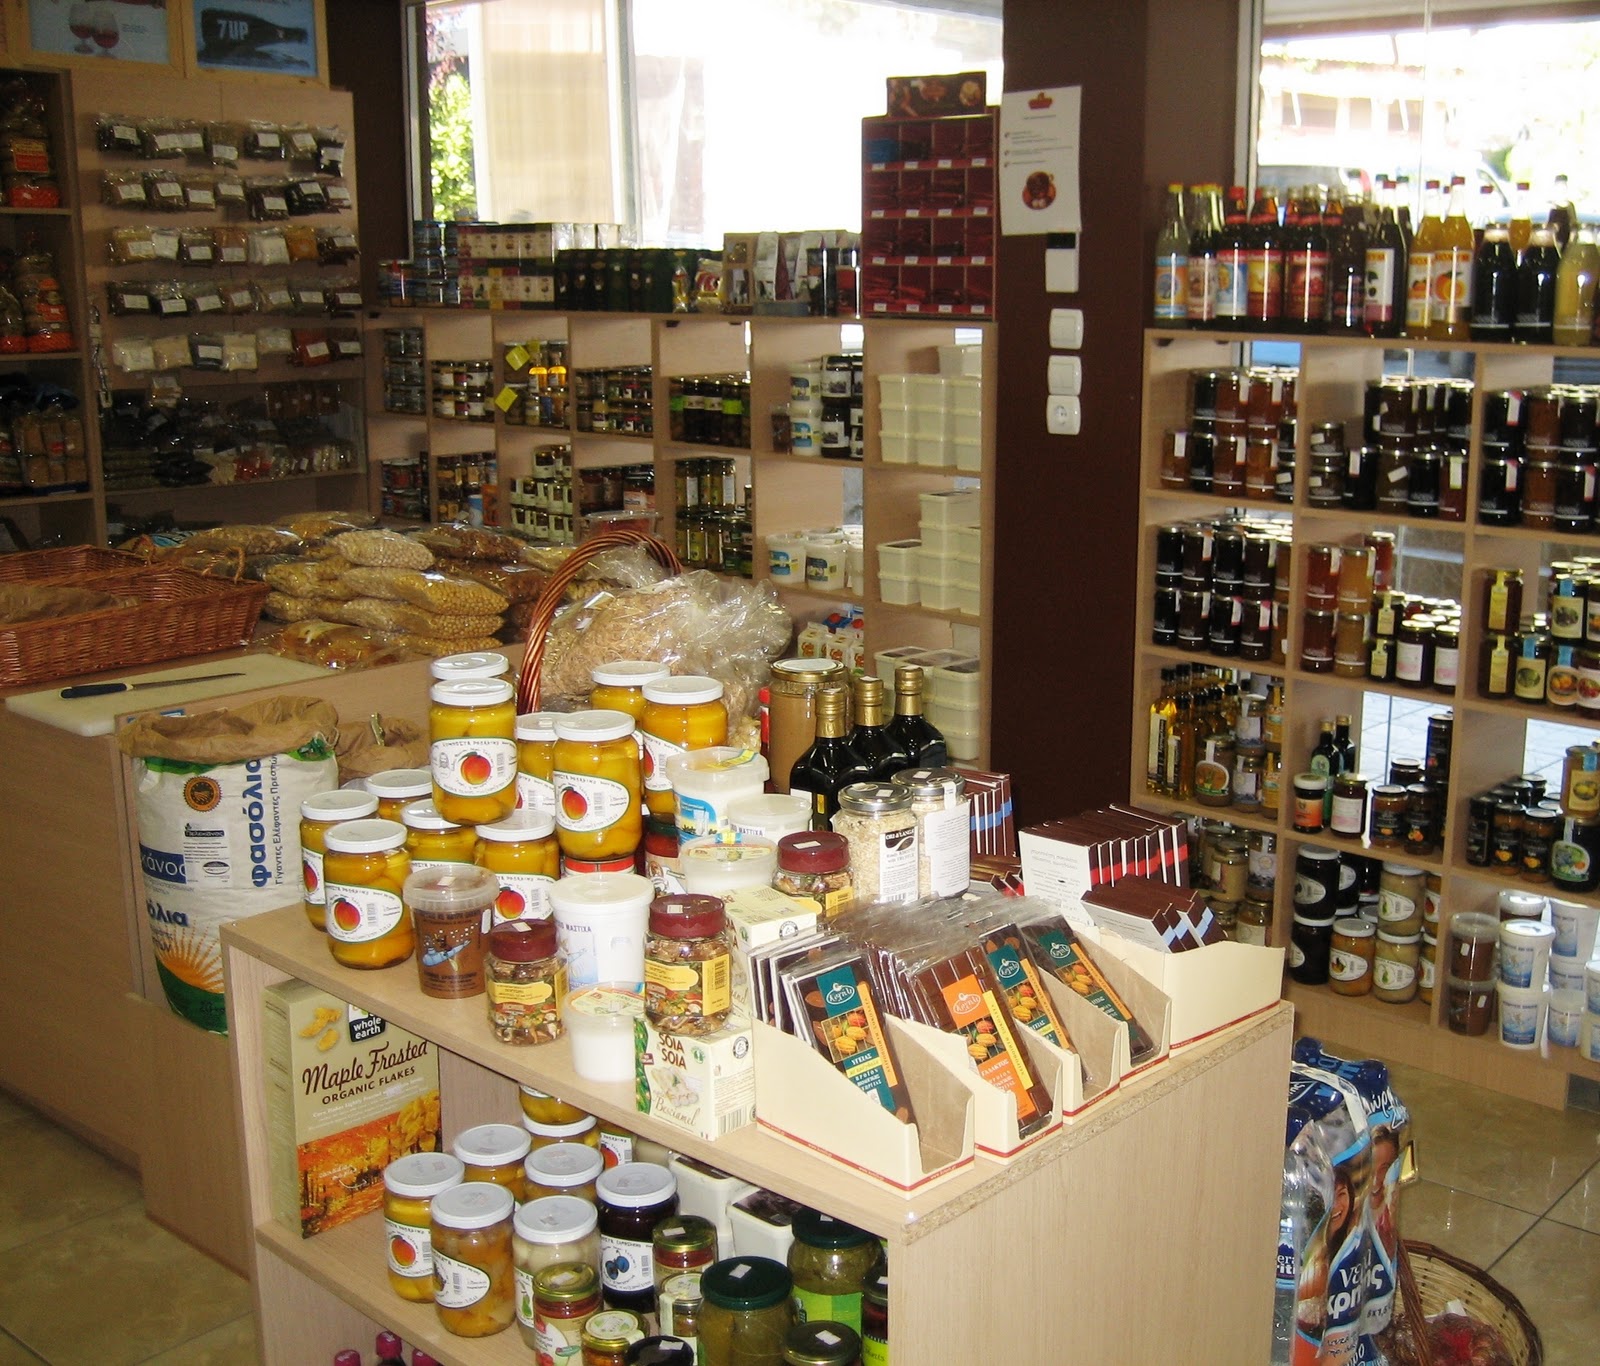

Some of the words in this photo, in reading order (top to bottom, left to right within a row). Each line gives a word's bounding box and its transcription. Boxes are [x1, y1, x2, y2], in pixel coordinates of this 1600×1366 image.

[353, 1016, 382, 1032] whole
[355, 1026, 381, 1040] earth
[658, 1033, 685, 1054] SOIA
[302, 1056, 364, 1095] Maple
[365, 1041, 428, 1079] Frosted
[661, 1049, 687, 1070] SOIA
[322, 1083, 375, 1105] ORGANIC
[379, 1066, 416, 1086] FLAKES
